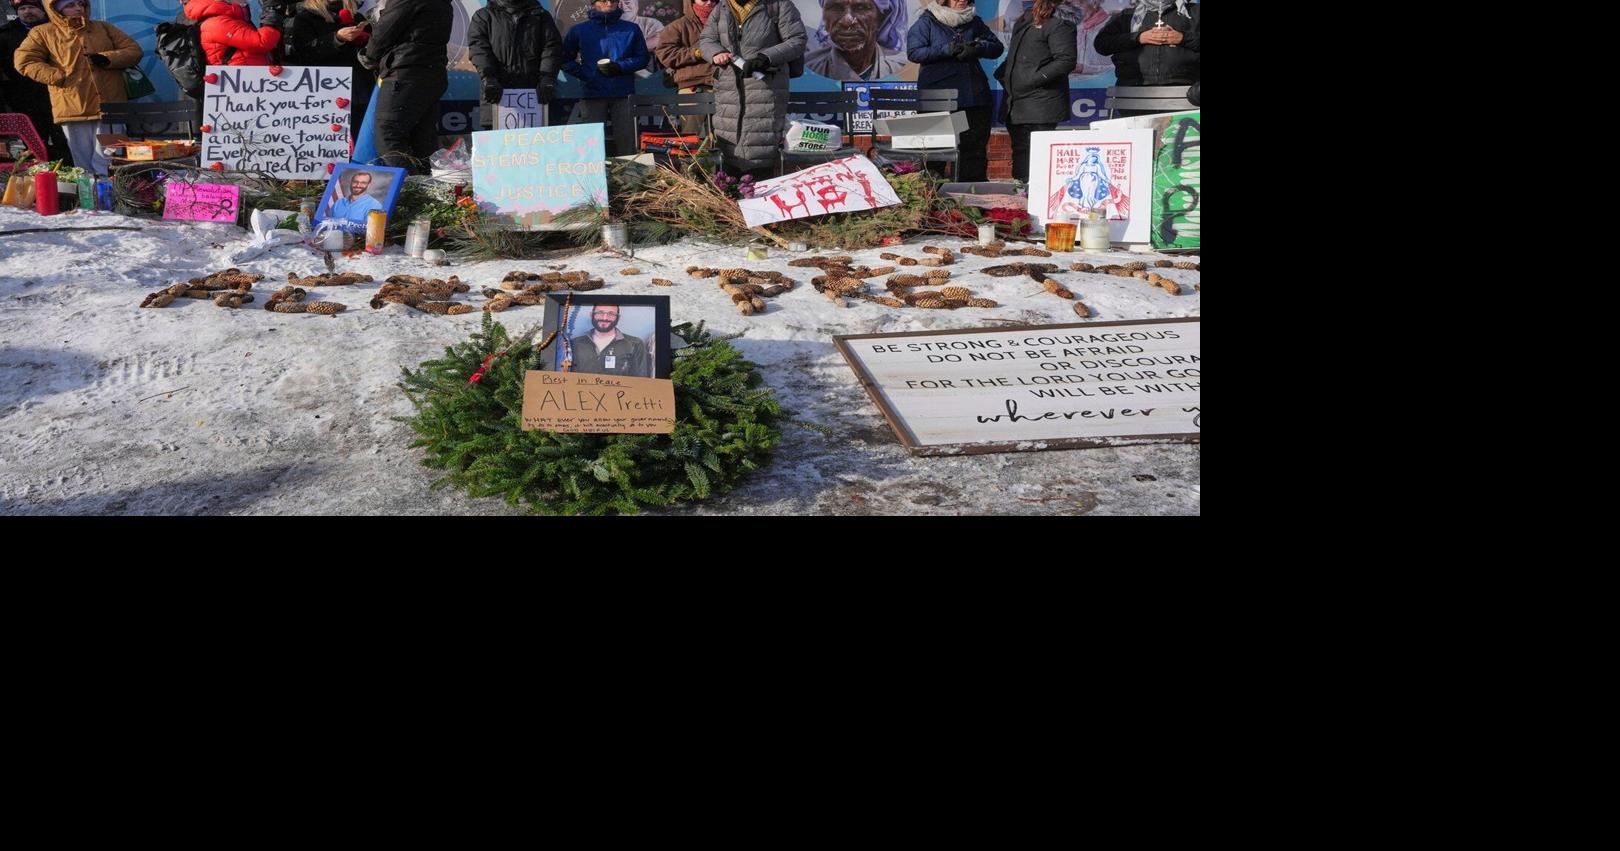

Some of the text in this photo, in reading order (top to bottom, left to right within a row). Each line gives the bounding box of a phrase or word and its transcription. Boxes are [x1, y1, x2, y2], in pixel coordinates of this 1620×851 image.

[220, 68, 350, 93] Nurse Alex
[207, 94, 331, 115] Thank you for
[504, 92, 536, 109] ICE
[208, 113, 252, 132] Your
[505, 112, 536, 129] OUT
[208, 128, 349, 145] and Love toward
[503, 129, 577, 147] PEACE
[802, 131, 829, 141] HOME
[207, 144, 349, 162] Everyone You have
[473, 152, 539, 168] STEMS
[296, 158, 321, 173] For
[545, 161, 604, 176] FROM
[495, 183, 582, 200] JUSTICE
[872, 344, 902, 353] BE
[907, 339, 1002, 352] STRONG
[1024, 330, 1180, 346] COURAGEOUS
[927, 345, 1144, 363] DO NOT BE AFRAID
[1040, 354, 1200, 371] OR DISCOURA
[577, 377, 588, 385] in
[595, 377, 621, 386] Peace
[906, 380, 958, 389] FOR
[961, 377, 1013, 388] THE
[1016, 374, 1085, 386] LORD
[1088, 370, 1162, 382] YOUR
[1029, 382, 1200, 398] WILL BE WITH
[541, 390, 663, 412] ALEX Pretti
[977, 399, 1156, 423] wherever
